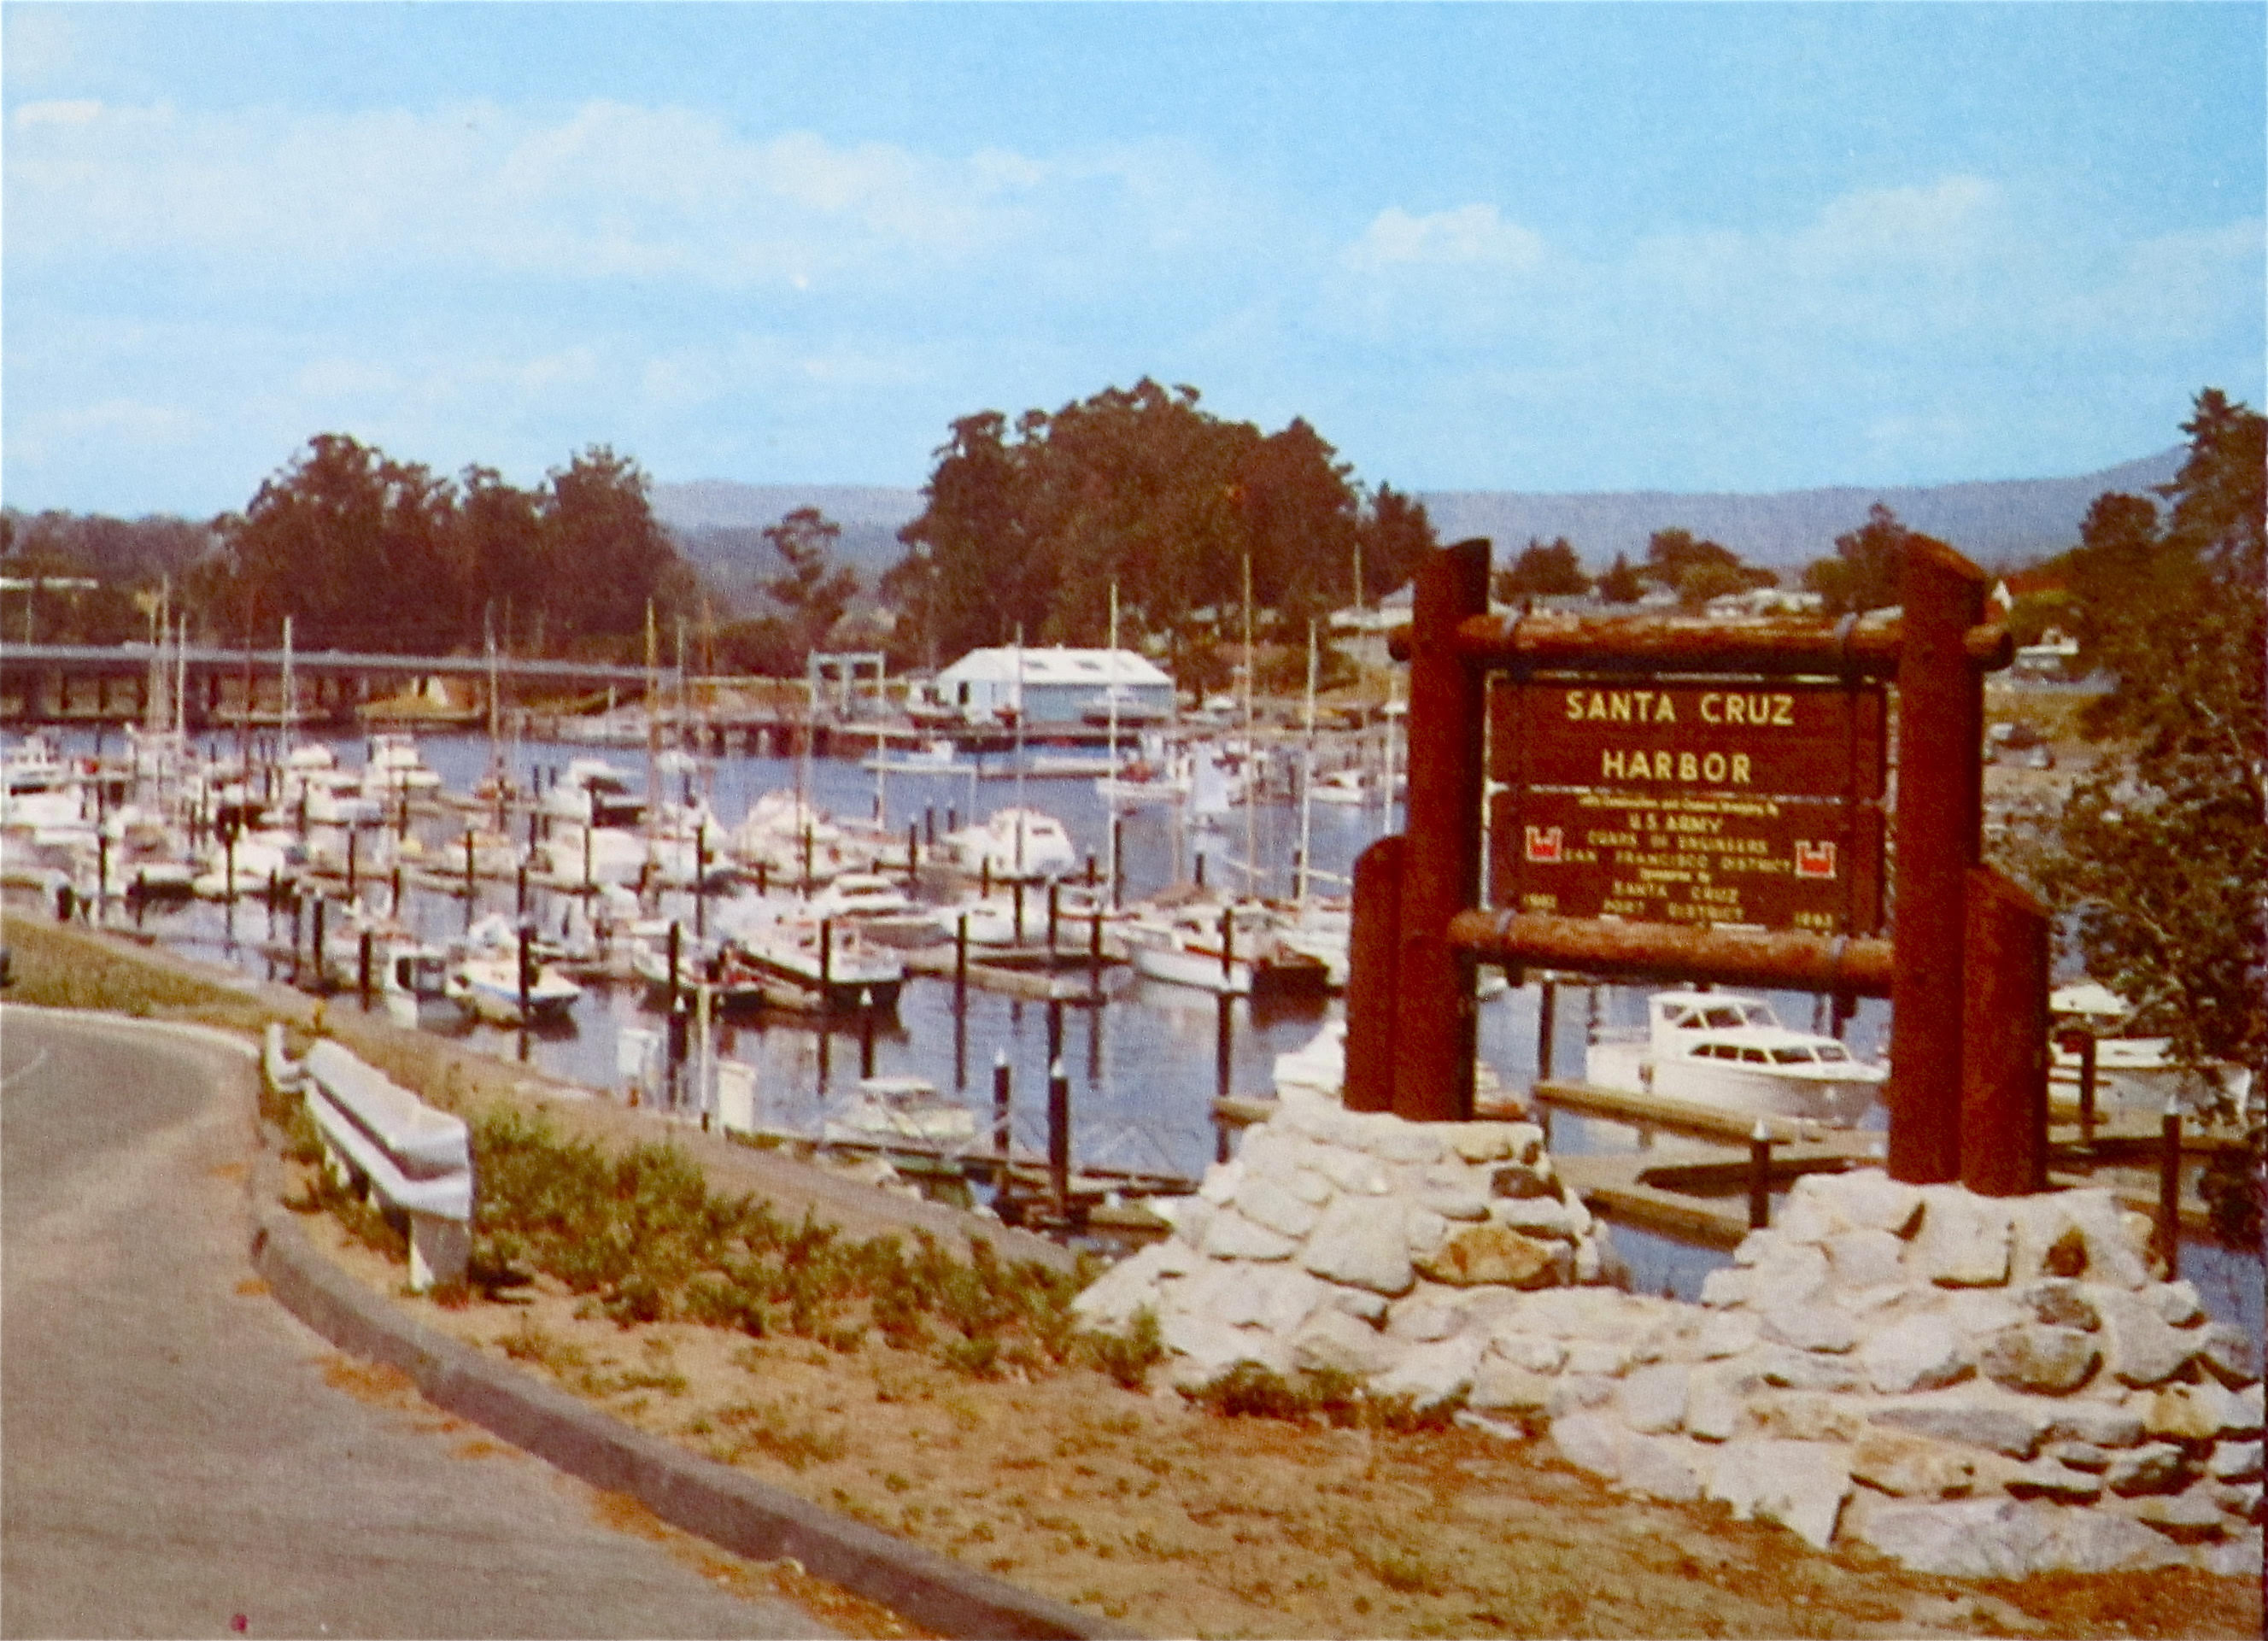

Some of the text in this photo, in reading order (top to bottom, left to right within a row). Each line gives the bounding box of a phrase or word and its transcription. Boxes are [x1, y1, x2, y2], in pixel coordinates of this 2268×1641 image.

[1565, 690, 1795, 726] SANTA CRUZ
[1601, 748, 1752, 782] HARBOR
[1665, 814, 1724, 834] ARMY
[1691, 886, 1739, 904] CRUZ
